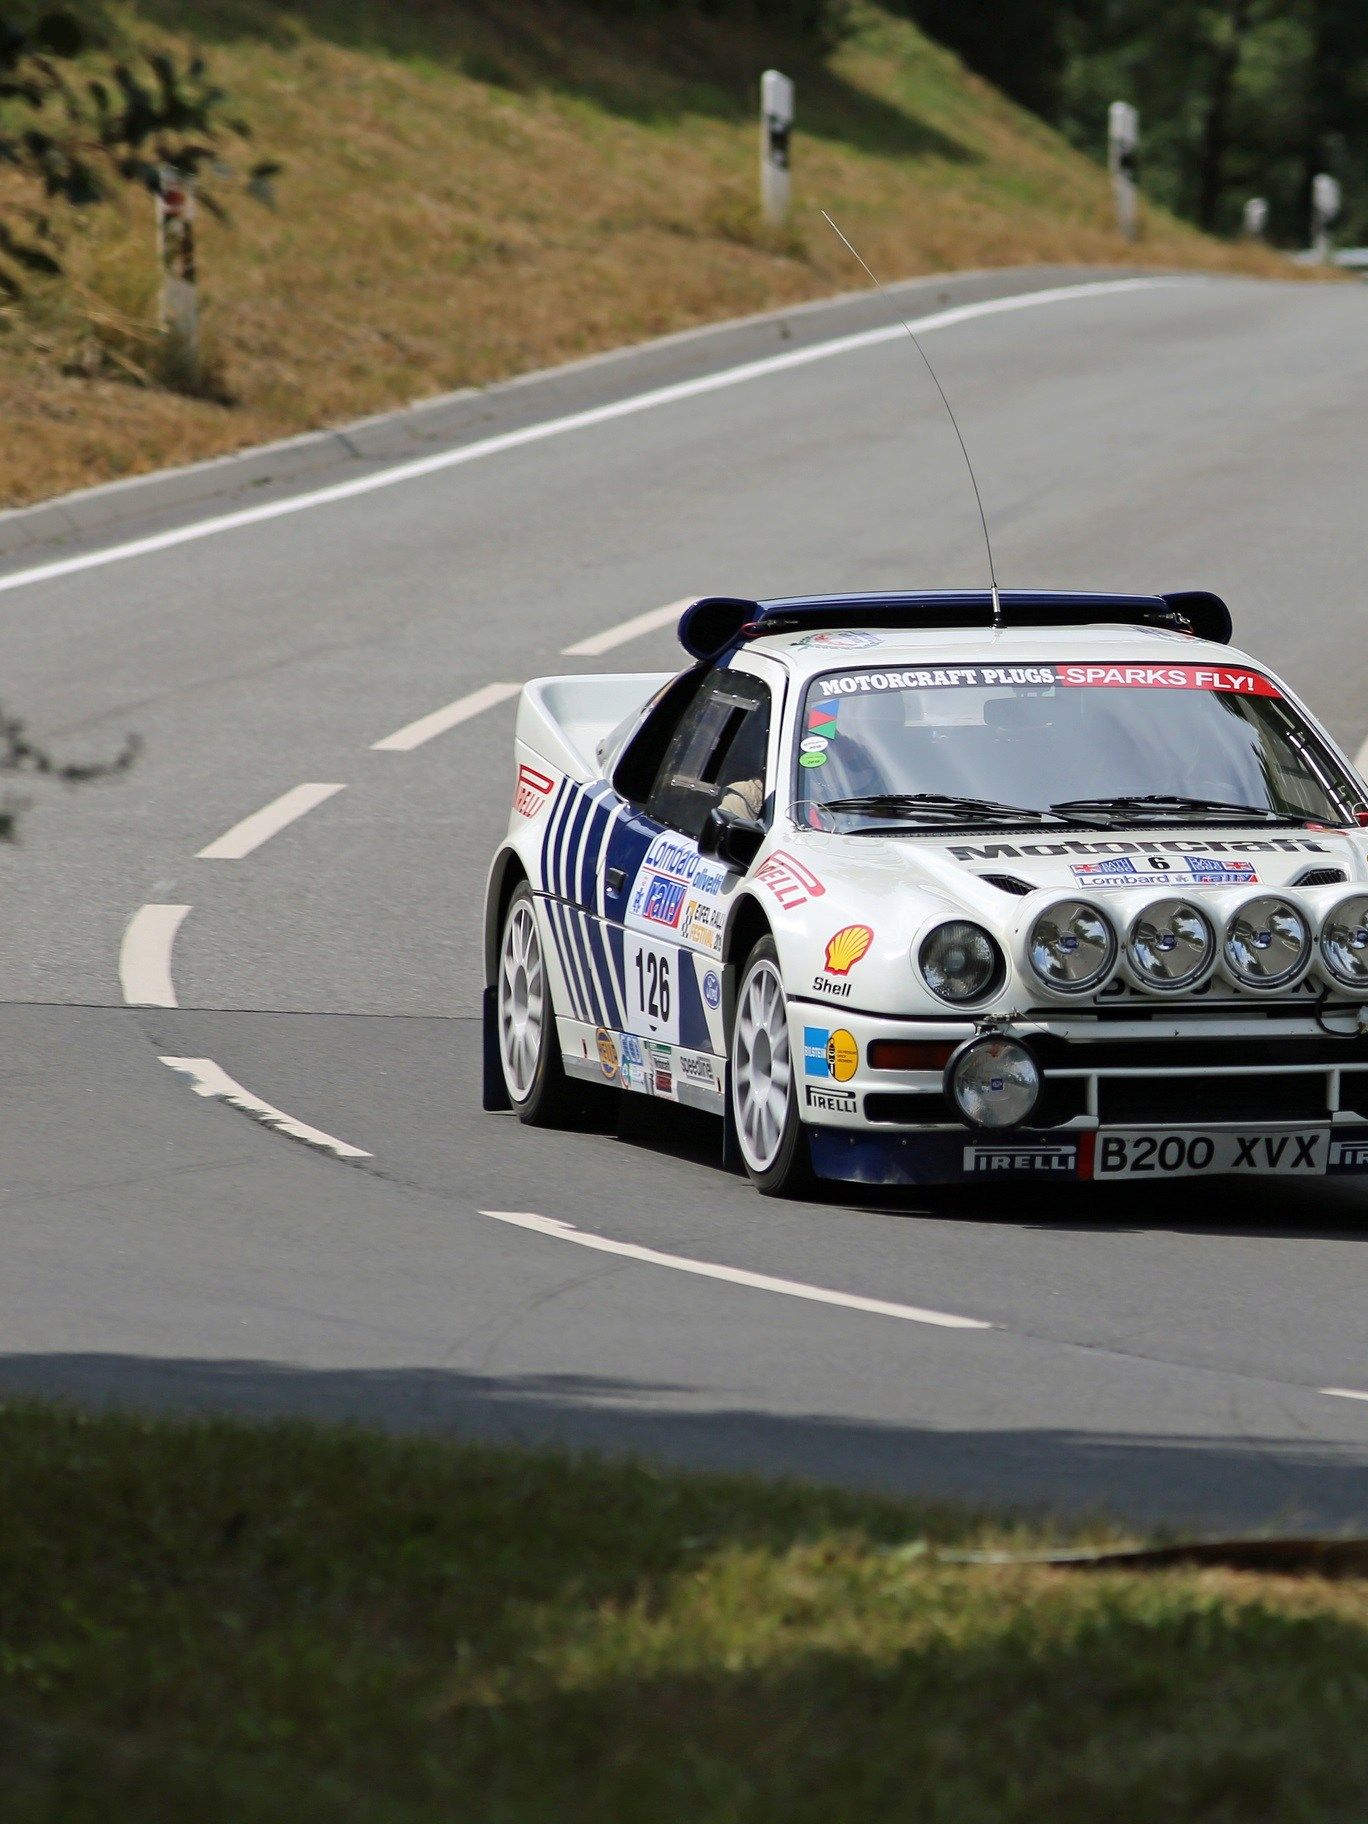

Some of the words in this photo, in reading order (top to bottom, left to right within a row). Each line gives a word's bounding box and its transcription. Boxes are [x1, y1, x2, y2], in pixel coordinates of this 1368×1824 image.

[819, 669, 977, 696] MOTORCRAFT
[1195, 670, 1255, 692] FLY!
[645, 833, 702, 878] Lombard
[945, 838, 1332, 861] Motorcraft
[1147, 856, 1170, 870] 6
[753, 848, 826, 911] PIRELLI
[1079, 874, 1170, 886] Lombard
[643, 879, 688, 924] rally
[635, 947, 671, 1022] 126
[812, 976, 852, 998] Shell
[805, 1084, 858, 1113] PIRELLI
[963, 1145, 1077, 1172] PIRELLI
[1101, 1135, 1215, 1173] B200
[1230, 1134, 1318, 1170] XVX
